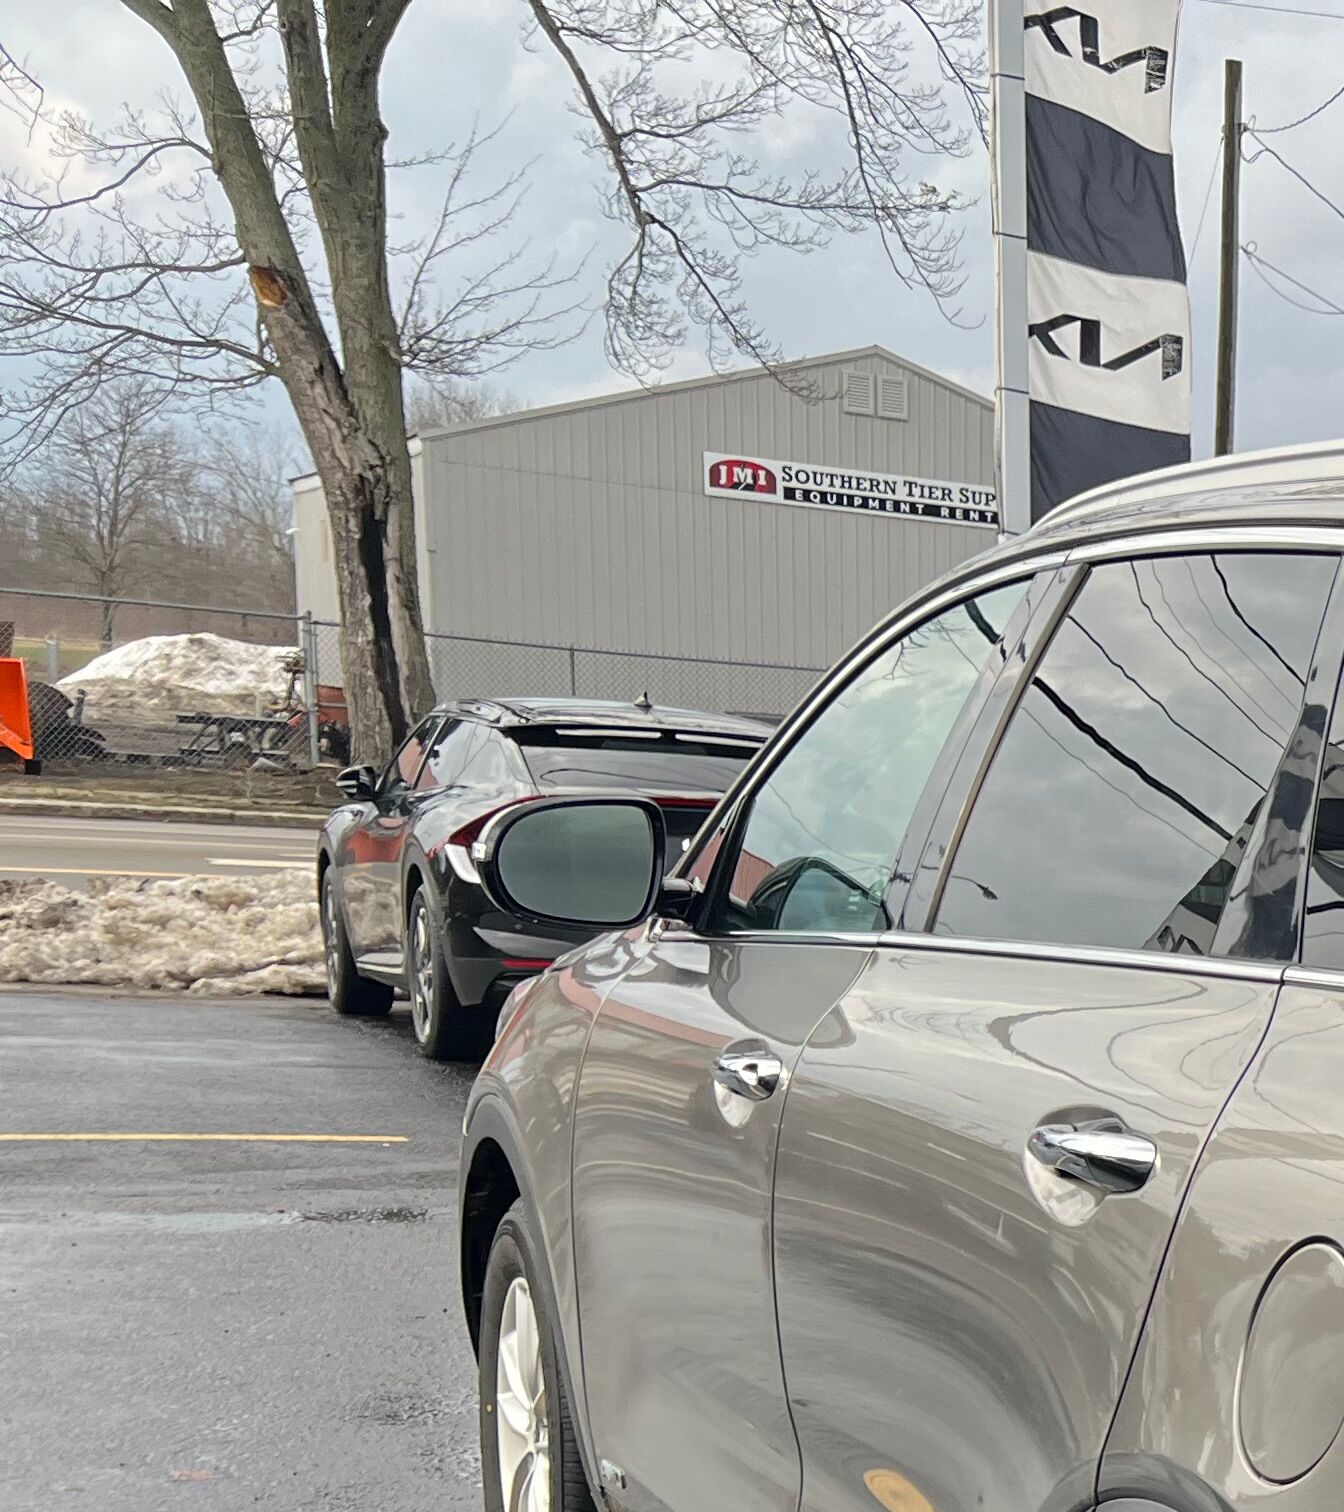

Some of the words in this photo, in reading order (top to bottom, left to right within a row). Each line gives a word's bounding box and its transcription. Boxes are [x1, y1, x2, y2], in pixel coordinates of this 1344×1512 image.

[718, 464, 767, 486] JMI
[782, 464, 897, 495] SOUTHERN
[903, 480, 953, 502] TIER
[794, 488, 925, 515] EQUIPMENT
[940, 506, 994, 523] RENT
